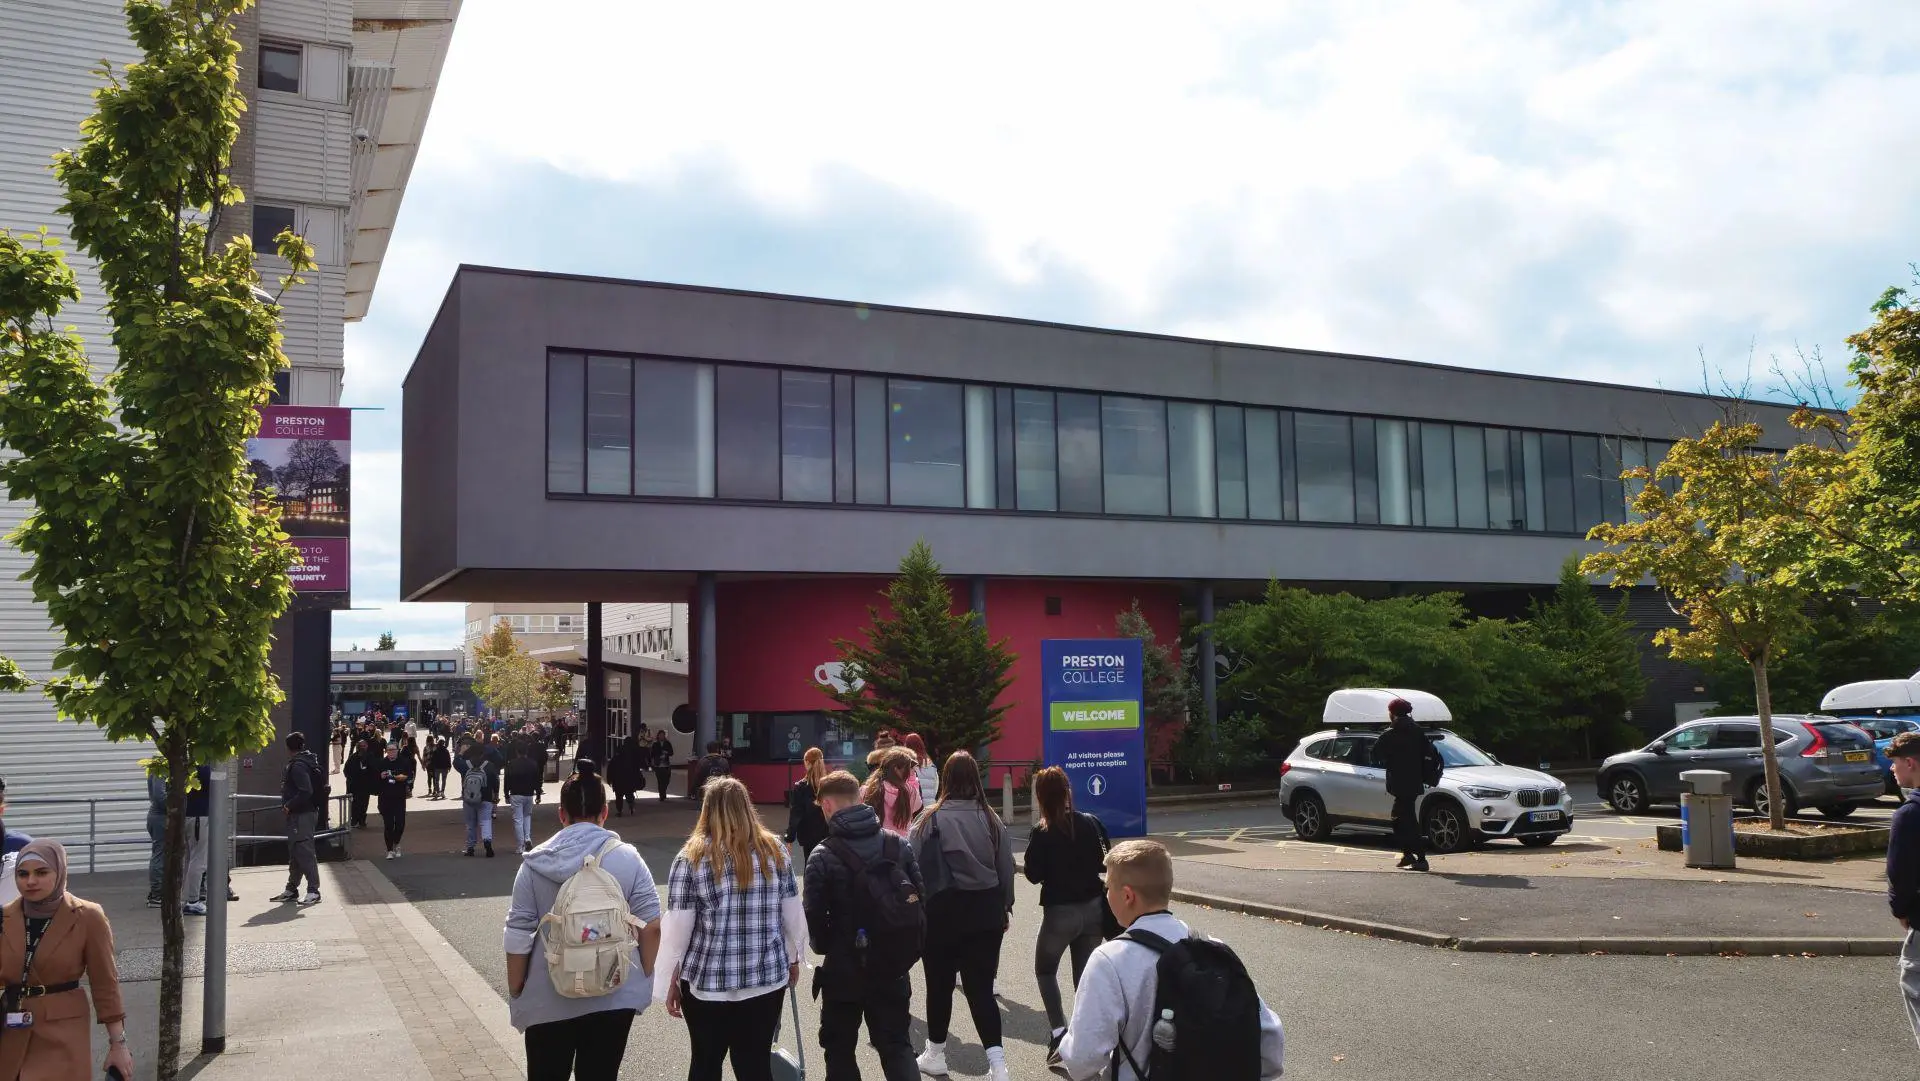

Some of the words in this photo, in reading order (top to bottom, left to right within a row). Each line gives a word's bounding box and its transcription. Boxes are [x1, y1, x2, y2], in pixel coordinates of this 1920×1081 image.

[275, 416, 325, 426] PRESTON
[275, 426, 325, 436] COLLEGE
[310, 546, 323, 554] TO
[1063, 655, 1124, 667] PRESTON
[1063, 671, 1124, 684] COLLEGE
[1063, 710, 1125, 722] WELCOME
[1103, 751, 1125, 759] please
[1065, 761, 1087, 769] report
[1096, 759, 1127, 768] reception
